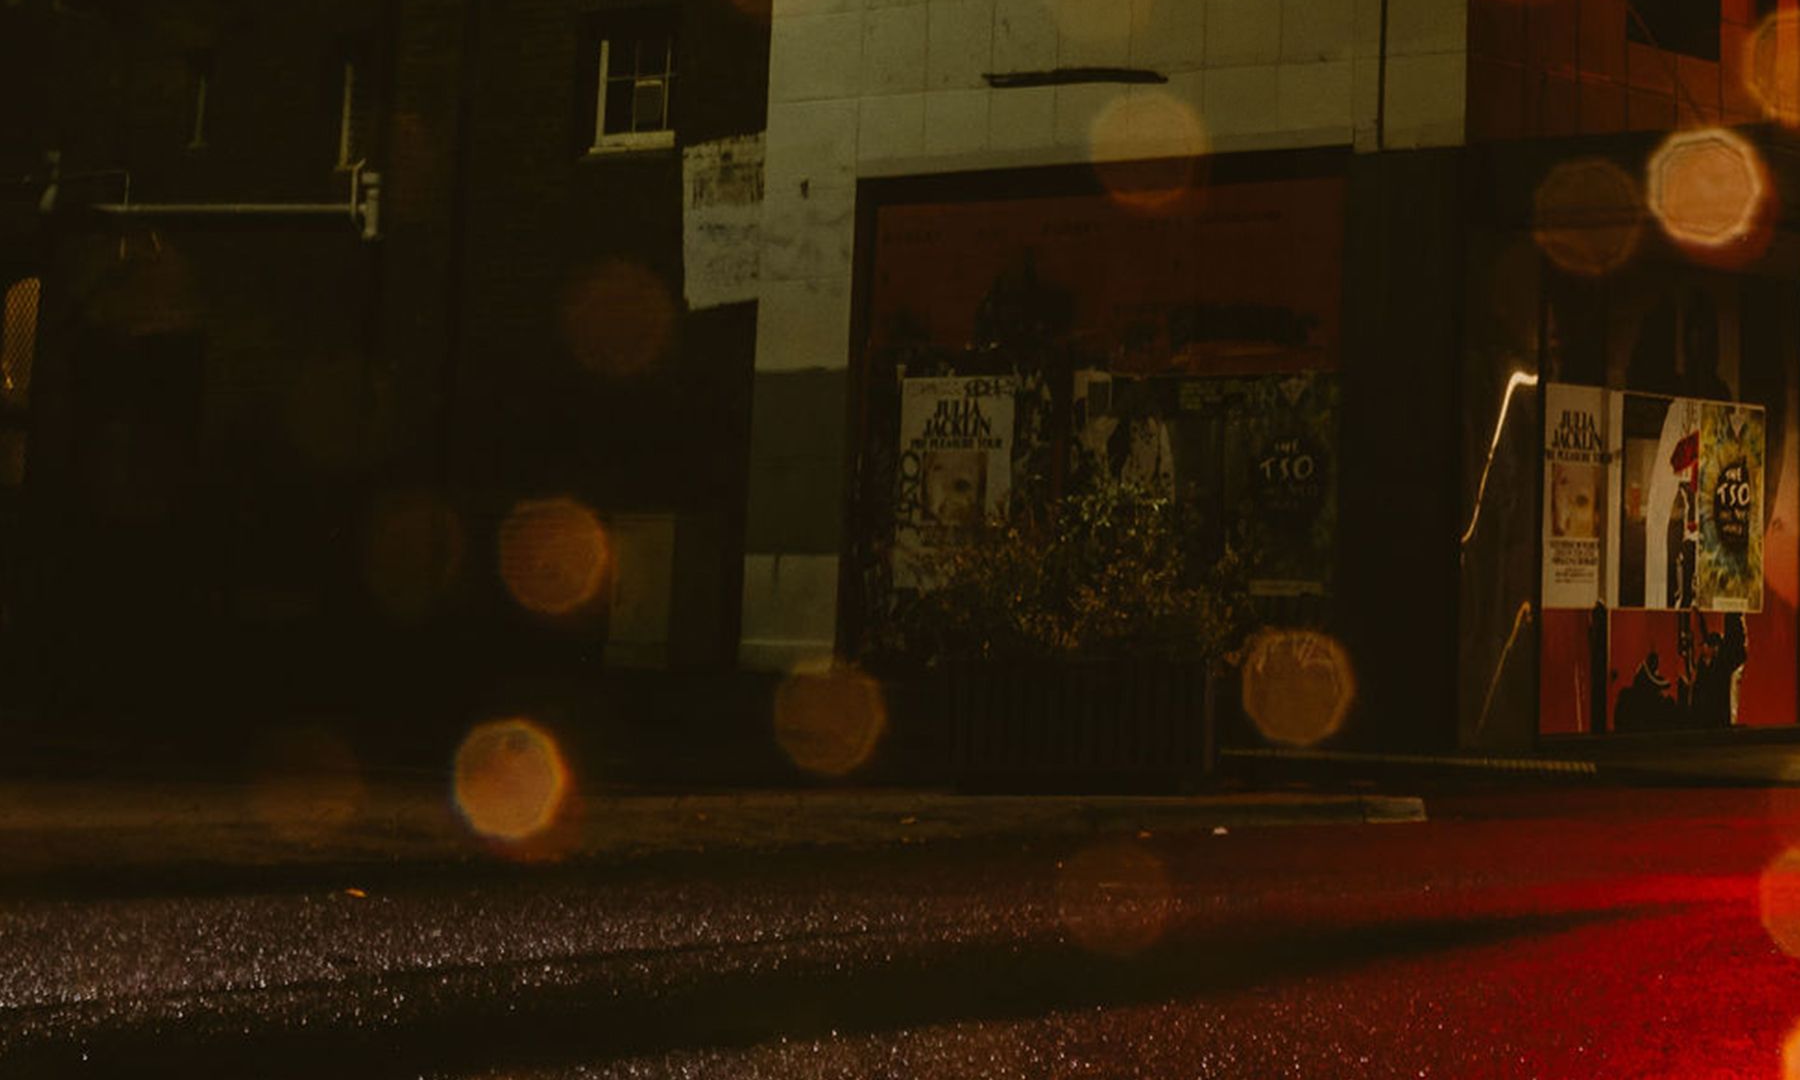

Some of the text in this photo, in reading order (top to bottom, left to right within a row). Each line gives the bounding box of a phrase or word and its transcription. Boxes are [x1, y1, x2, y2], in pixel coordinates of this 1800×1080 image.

[935, 400, 981, 419] JULIA
[923, 418, 993, 438] JACKLIN
[1559, 411, 1596, 430] JULIA
[1551, 429, 1603, 450] JACKLIN
[1260, 455, 1313, 481] TSO
[1725, 467, 1741, 482] THE
[1716, 482, 1750, 505] TSO
